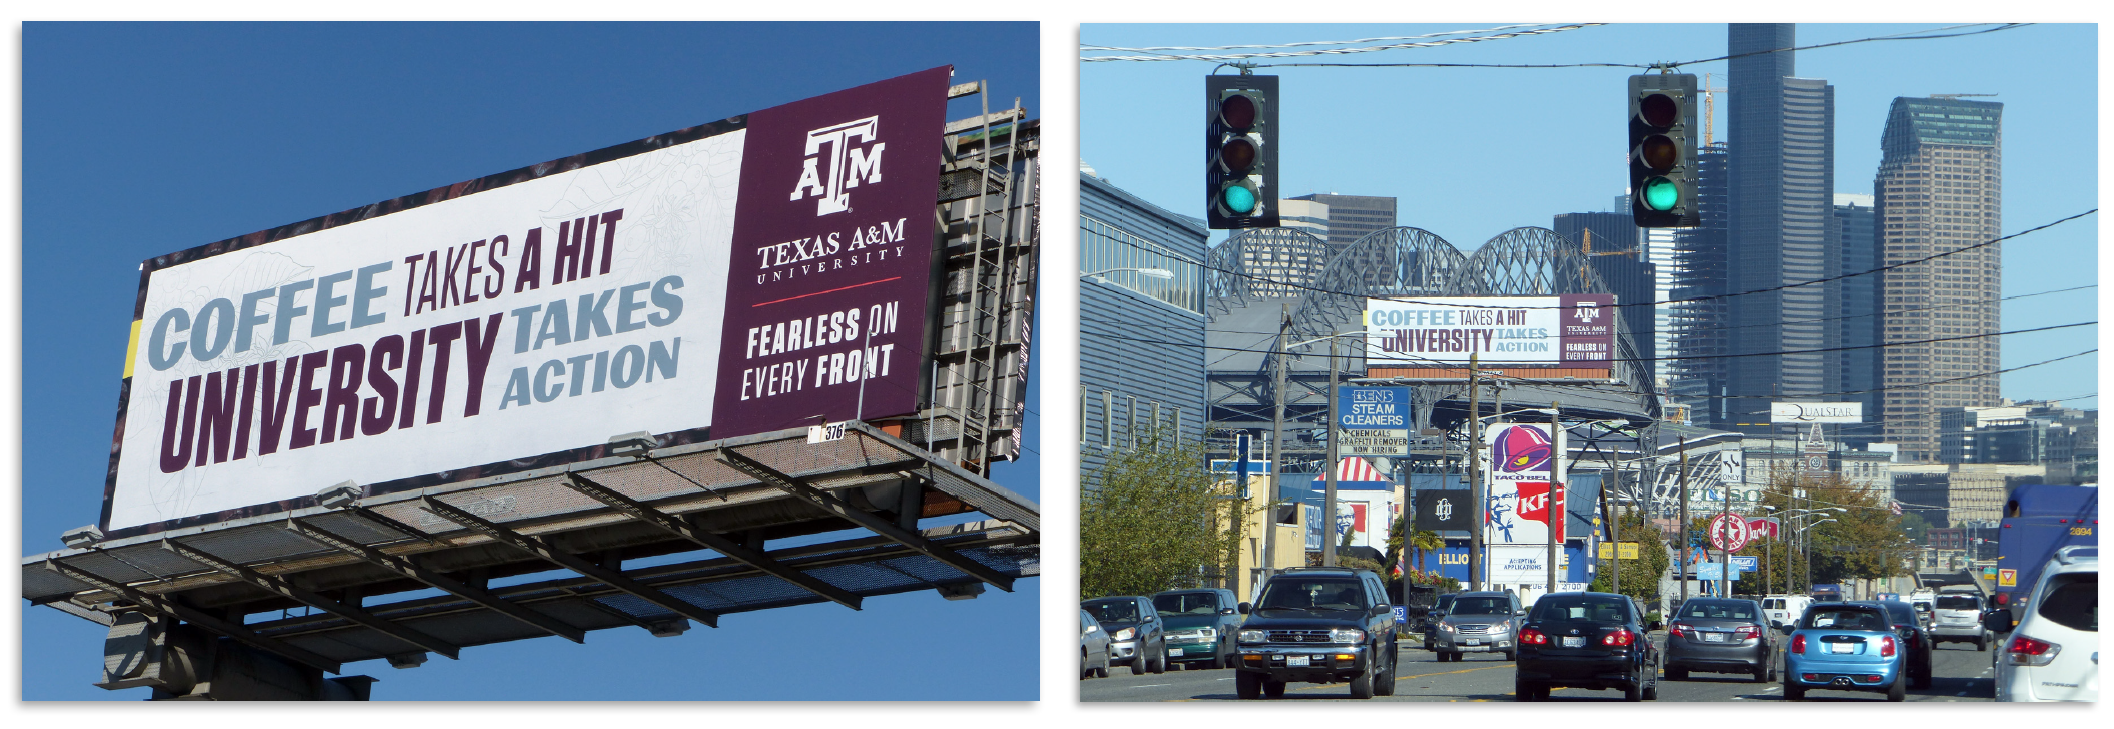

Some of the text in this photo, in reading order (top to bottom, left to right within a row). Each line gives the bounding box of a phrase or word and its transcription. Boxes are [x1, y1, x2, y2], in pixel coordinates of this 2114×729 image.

[756, 217, 907, 270] TEXAS A&M
[756, 246, 905, 285] UNIVERSITY
[147, 208, 625, 372] COFFEE TAKES A HIT
[1371, 309, 1527, 326] COFFEE TAKES A HIT
[746, 300, 899, 360] FEARLESS ON
[1381, 327, 1549, 353] UNIVERSITY TAKES
[1495, 341, 1549, 353] ACTION
[1566, 343, 1607, 352] FEARLESS ON
[1566, 352, 1607, 361] EVERY FRONT
[158, 274, 685, 474] UNIVERSITY TAKES
[499, 336, 682, 410] ACTION
[740, 343, 895, 401] EVERY FRONT
[1352, 389, 1394, 403] BENS
[1352, 403, 1395, 414] STEAM
[1342, 414, 1404, 426] CLEANERS
[825, 423, 845, 441] 376
[1350, 429, 1391, 437] CHEMICALS
[1373, 437, 1408, 446] REMOVER
[1372, 446, 1398, 454] HIRING
[1722, 473, 1741, 482] ONLY
